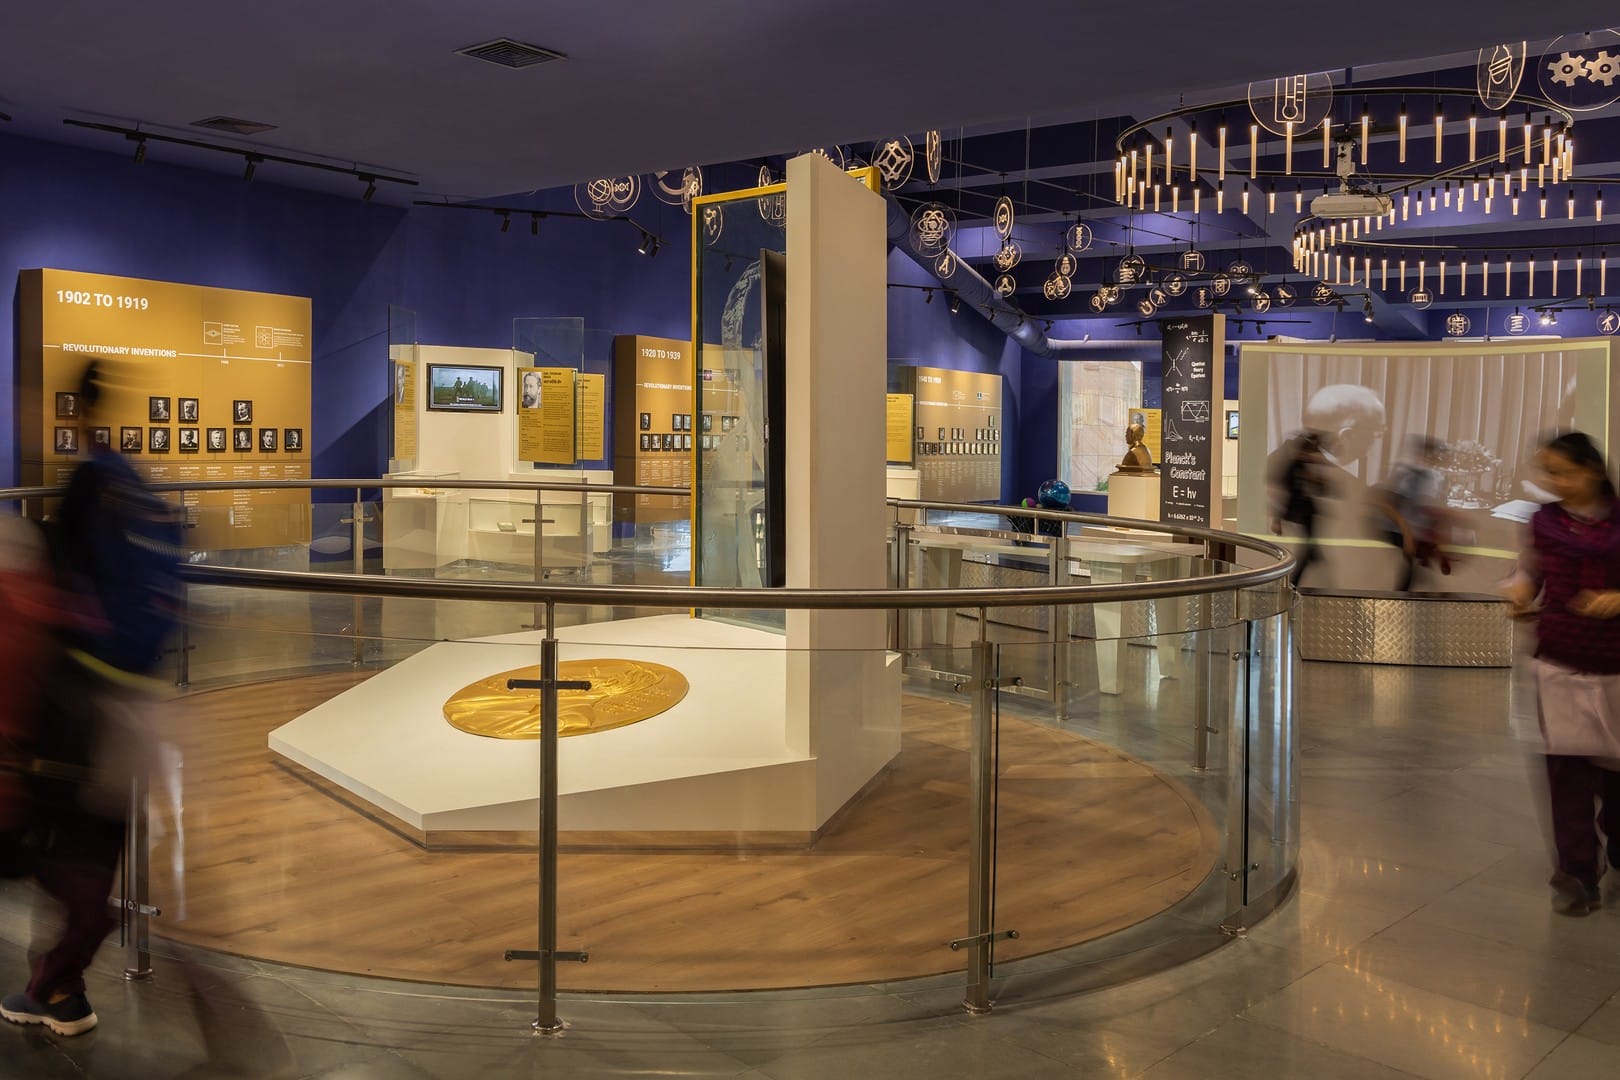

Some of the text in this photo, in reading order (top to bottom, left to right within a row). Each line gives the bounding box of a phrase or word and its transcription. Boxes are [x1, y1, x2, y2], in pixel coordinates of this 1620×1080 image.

[57, 290, 149, 310] 1902 TO 1919
[63, 344, 176, 357] REVOLUTIONARY INVENTIONS
[642, 348, 680, 360] 1920 TO 1939
[1165, 451, 1196, 465] Planck's
[1170, 466, 1206, 480] Constant
[1173, 486, 1179, 497] E
